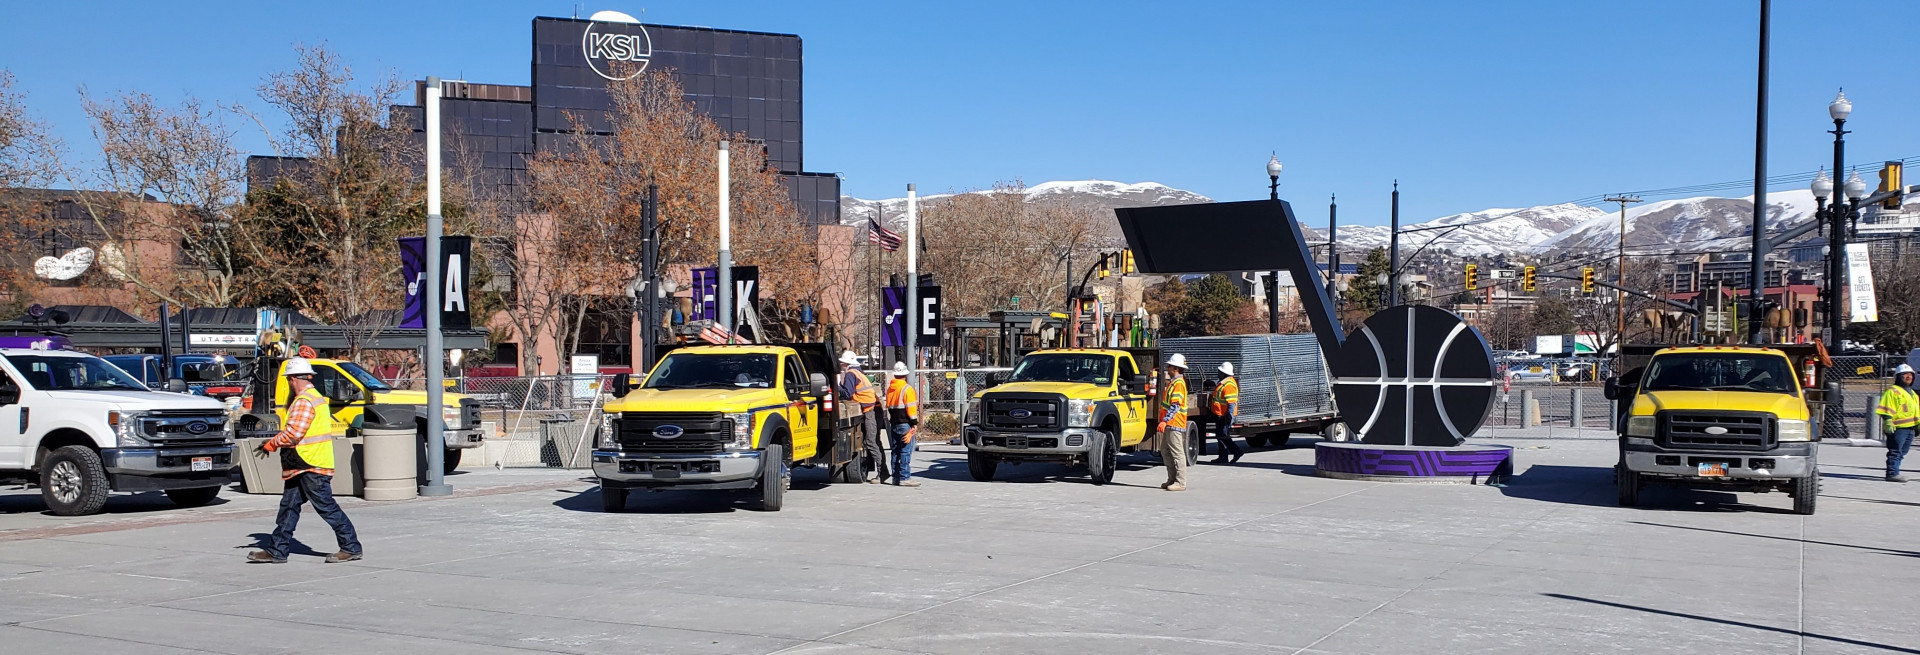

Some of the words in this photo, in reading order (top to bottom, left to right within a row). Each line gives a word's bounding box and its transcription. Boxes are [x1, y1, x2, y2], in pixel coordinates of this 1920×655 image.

[590, 32, 651, 61] KSL
[444, 253, 466, 311] A
[1854, 284, 1871, 292] TICKETS
[922, 297, 937, 335] E
